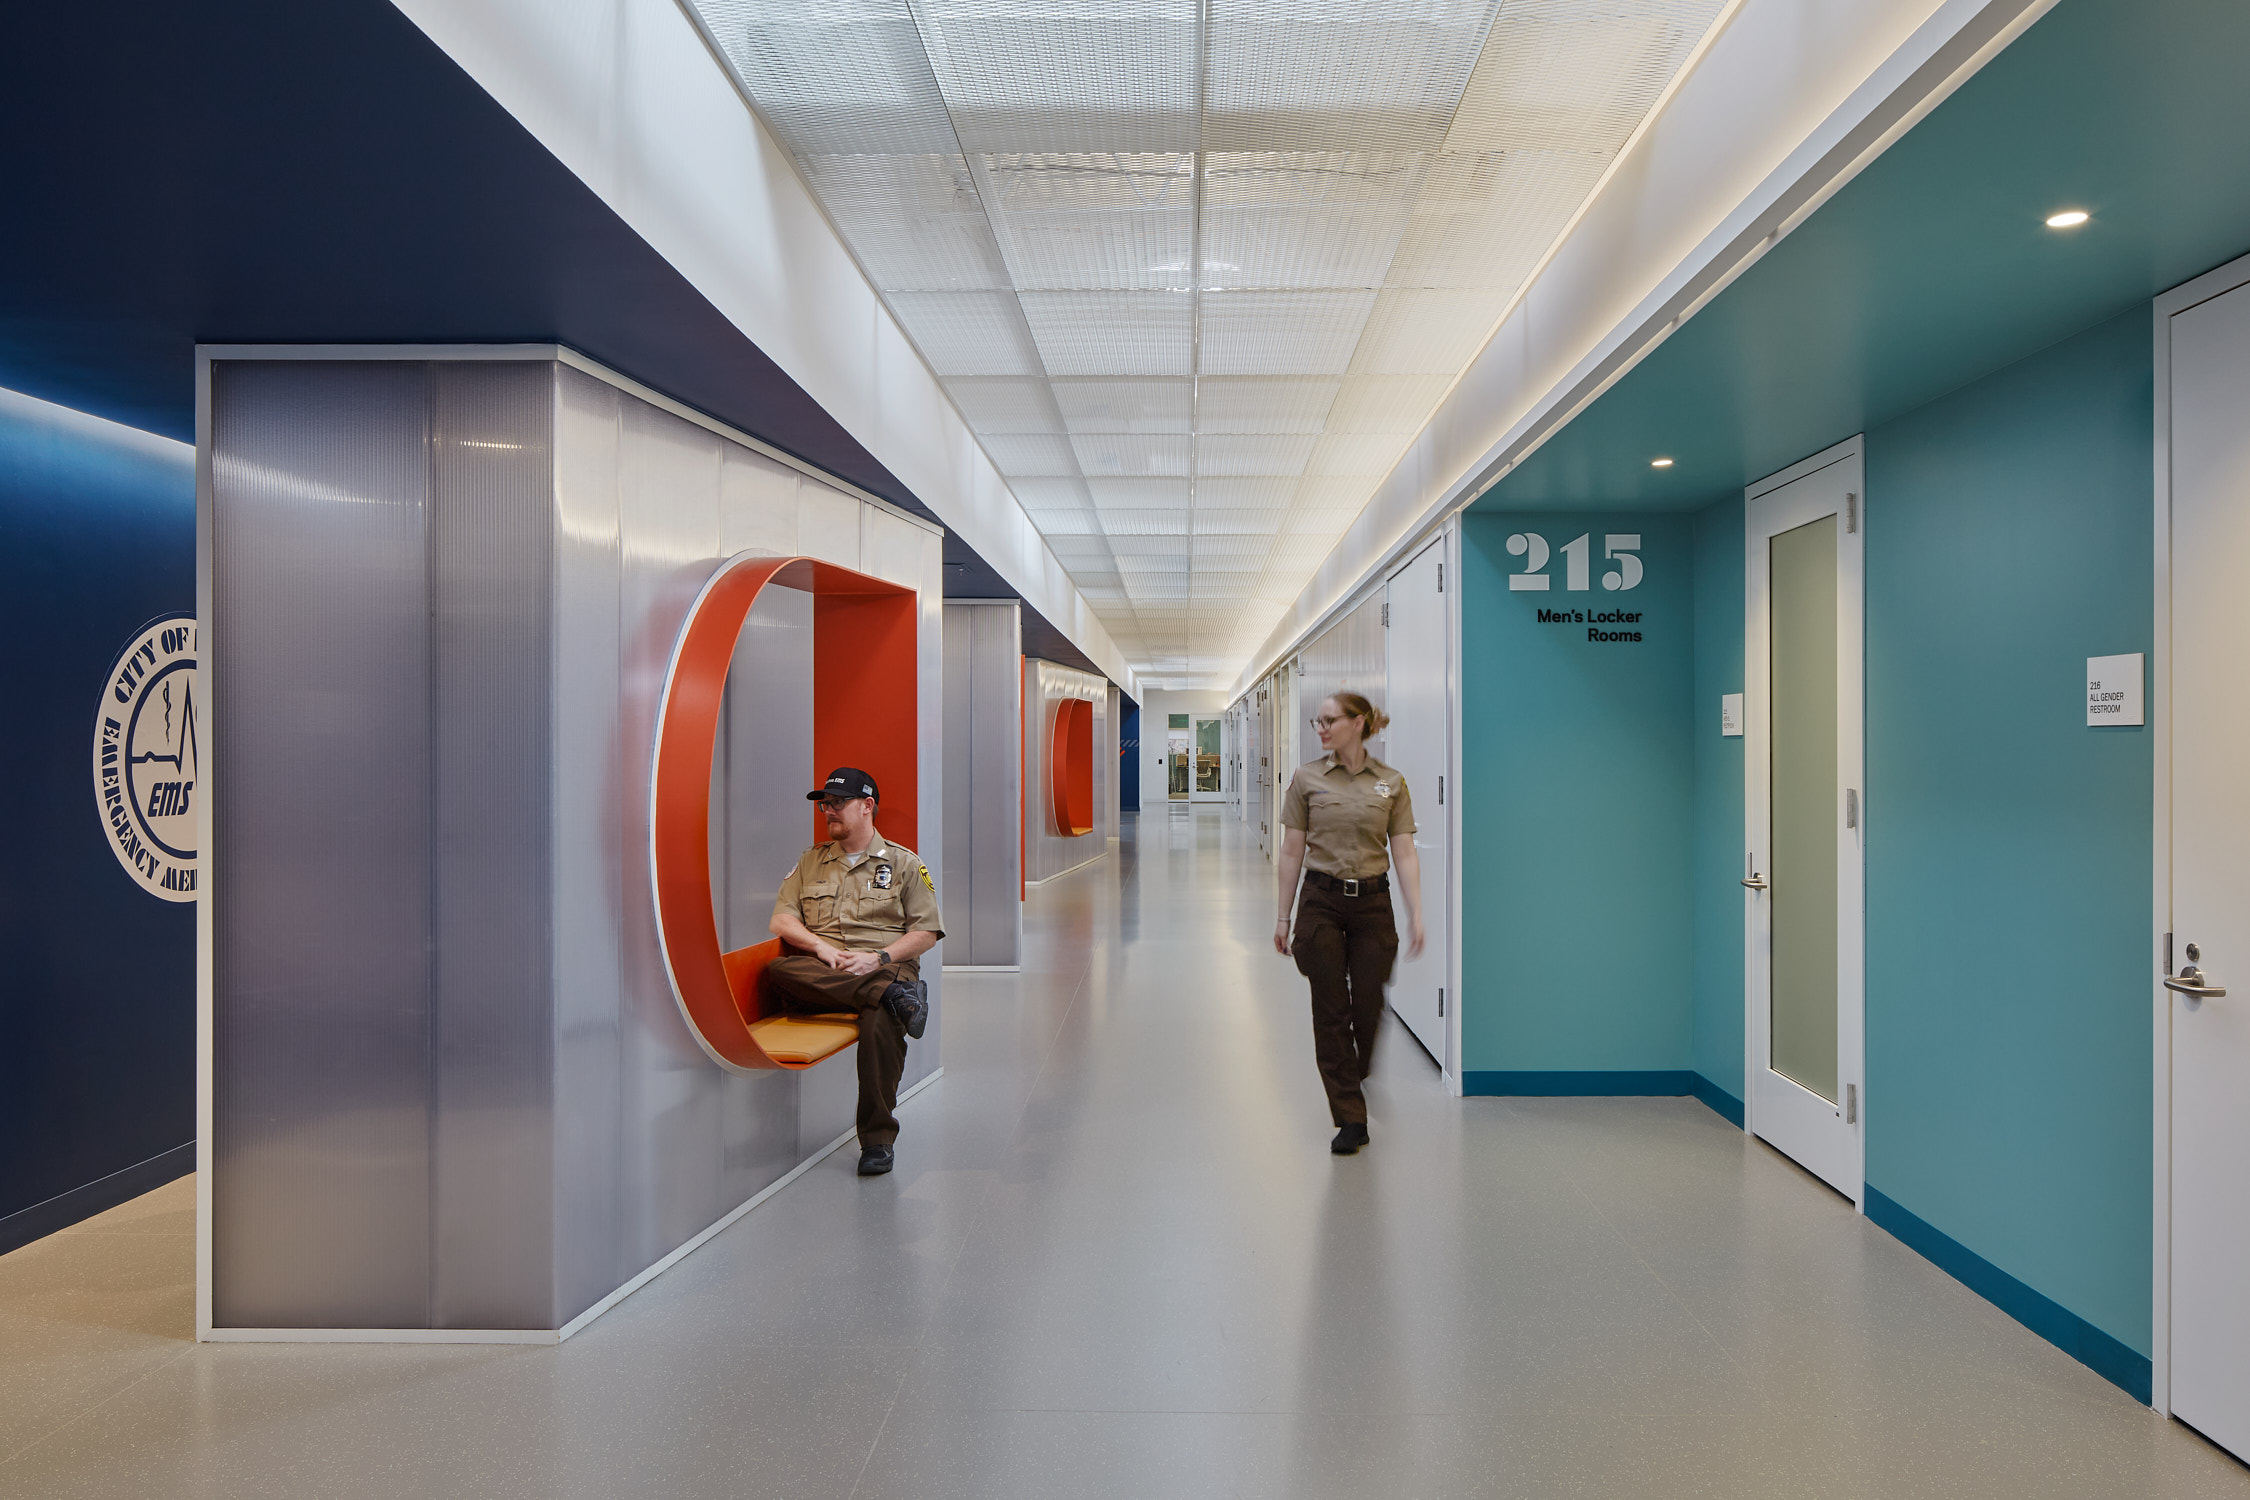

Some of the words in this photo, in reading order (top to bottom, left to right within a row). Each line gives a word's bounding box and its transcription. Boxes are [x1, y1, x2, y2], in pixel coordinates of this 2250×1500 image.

[1506, 532, 1643, 591] 215
[1537, 609, 1583, 623] Men's
[1587, 609, 1642, 623] Locker
[1588, 628, 1642, 642] Rooms
[115, 637, 157, 704] CITY
[161, 627, 188, 654] OF
[2090, 693, 2100, 702] ALL
[2101, 692, 2124, 701] GENDER
[2090, 705, 2121, 713] RESTROOM
[102, 716, 160, 880] EMERGENCY
[147, 781, 194, 817] EMS
